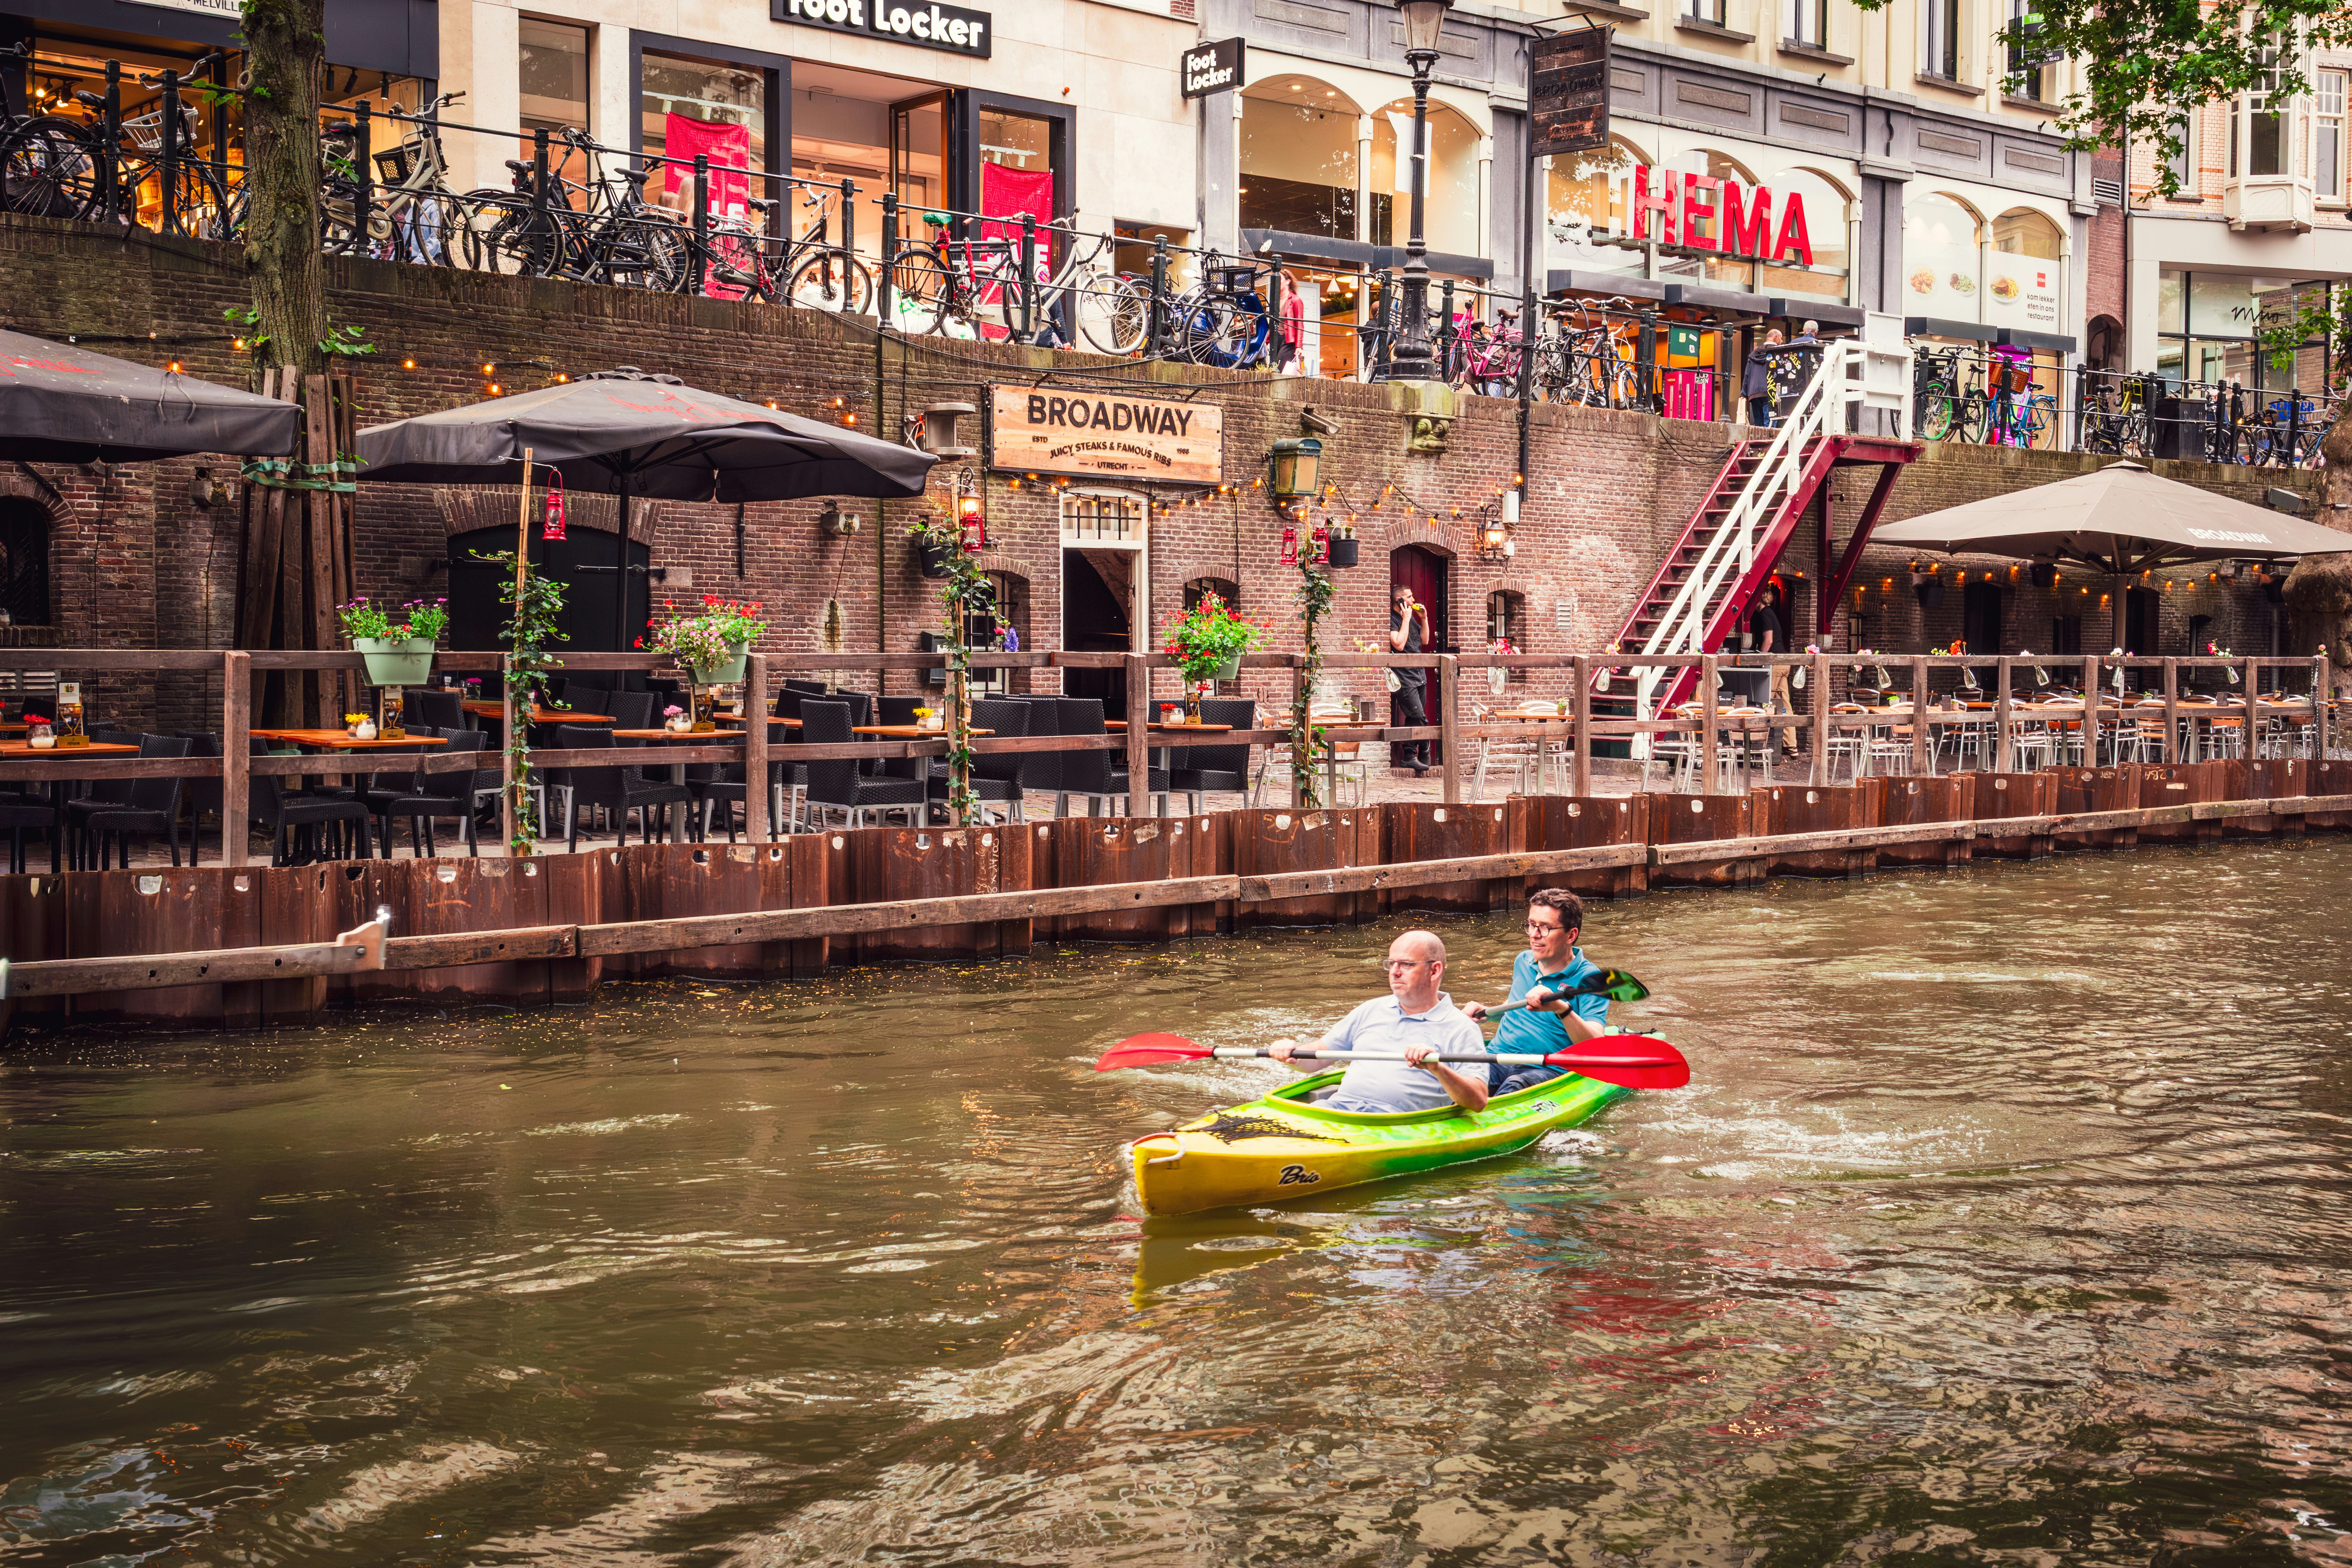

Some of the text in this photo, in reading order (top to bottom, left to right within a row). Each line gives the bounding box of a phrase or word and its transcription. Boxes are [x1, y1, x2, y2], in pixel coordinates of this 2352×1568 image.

[875, 0, 983, 47] Locker
[1187, 49, 1216, 73] Foot
[1187, 67, 1233, 91] Locker
[1534, 74, 1604, 99] BROADWAY
[1628, 164, 1813, 266] HEMA
[2039, 295, 2055, 303] lekker
[2027, 313, 2054, 321] restaurant
[1028, 394, 1193, 436] BROADWAY
[1050, 441, 1172, 466] JUICY STEAKS & FAMOUS RIBS
[1097, 461, 1129, 470] UTRECHT
[2186, 528, 2273, 544] BROADWAY
[1278, 1164, 1320, 1185] Brio
